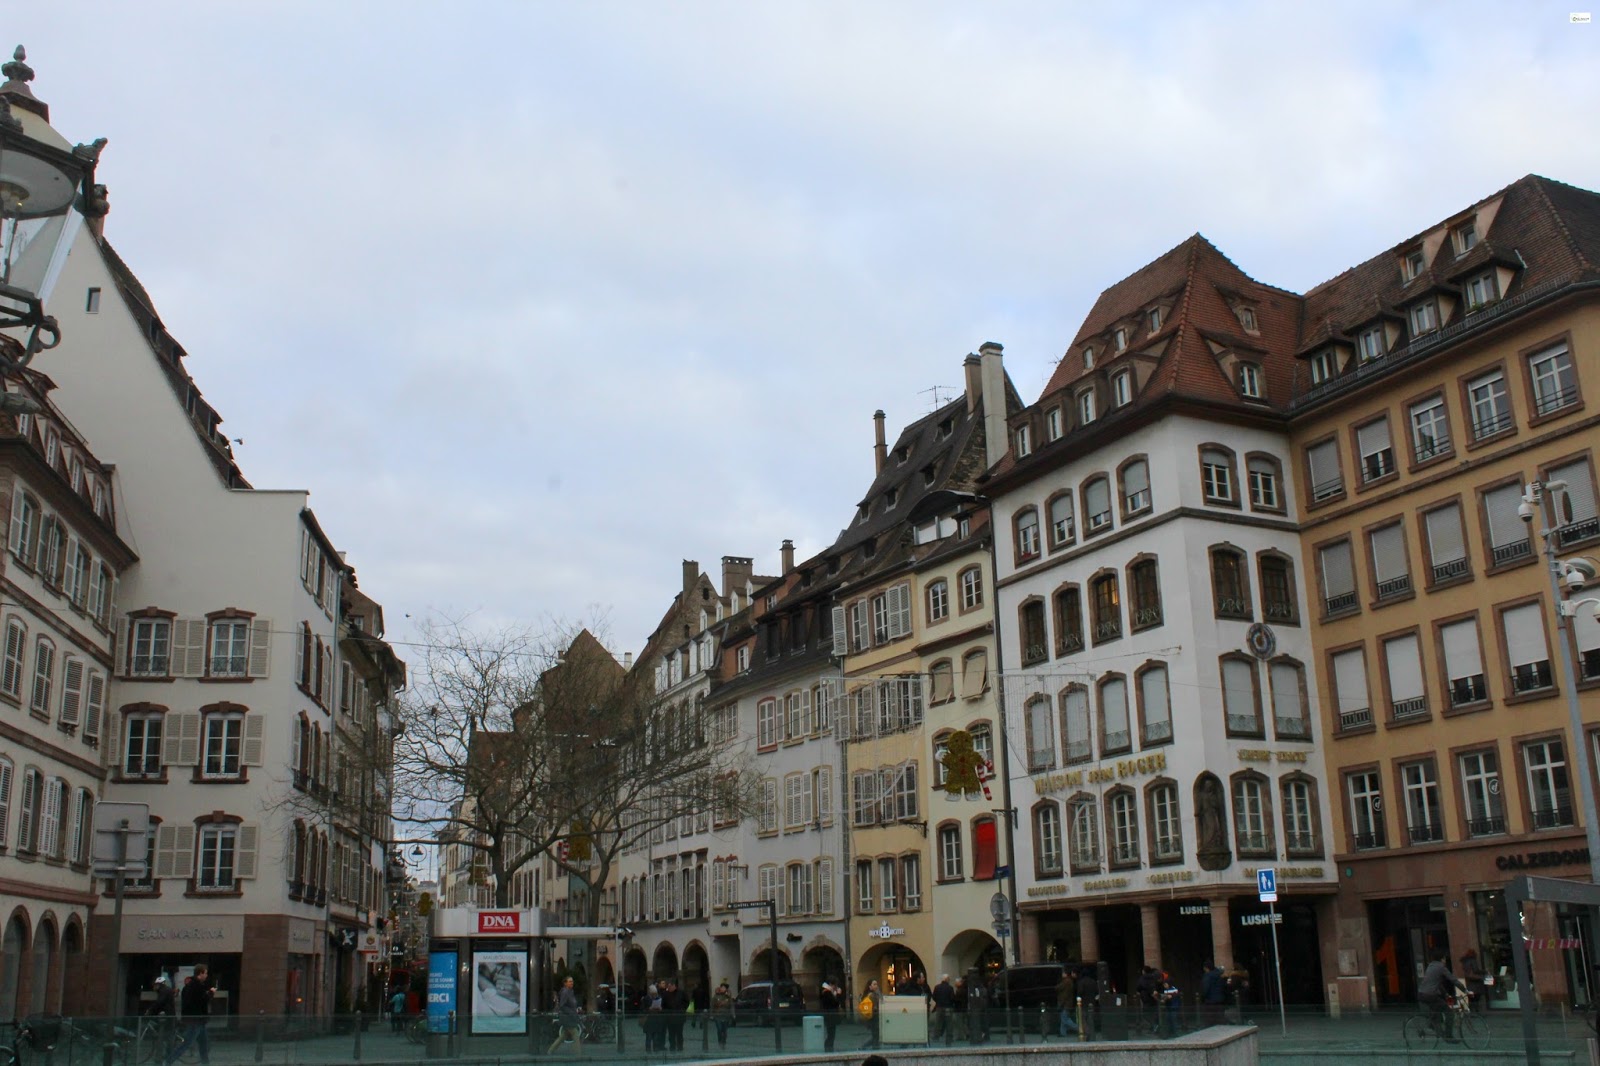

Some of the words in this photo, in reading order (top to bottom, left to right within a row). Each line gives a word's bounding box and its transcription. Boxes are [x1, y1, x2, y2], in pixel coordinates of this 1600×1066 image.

[1116, 751, 1167, 779] ROGER
[1495, 847, 1590, 871] CALZEDONI
[1180, 905, 1203, 915] LUSH
[483, 915, 515, 927] DNA
[1241, 913, 1270, 926] LUSH
[138, 927, 167, 940] SAN
[171, 927, 225, 940] MARINA
[428, 992, 450, 1003] ERCI
